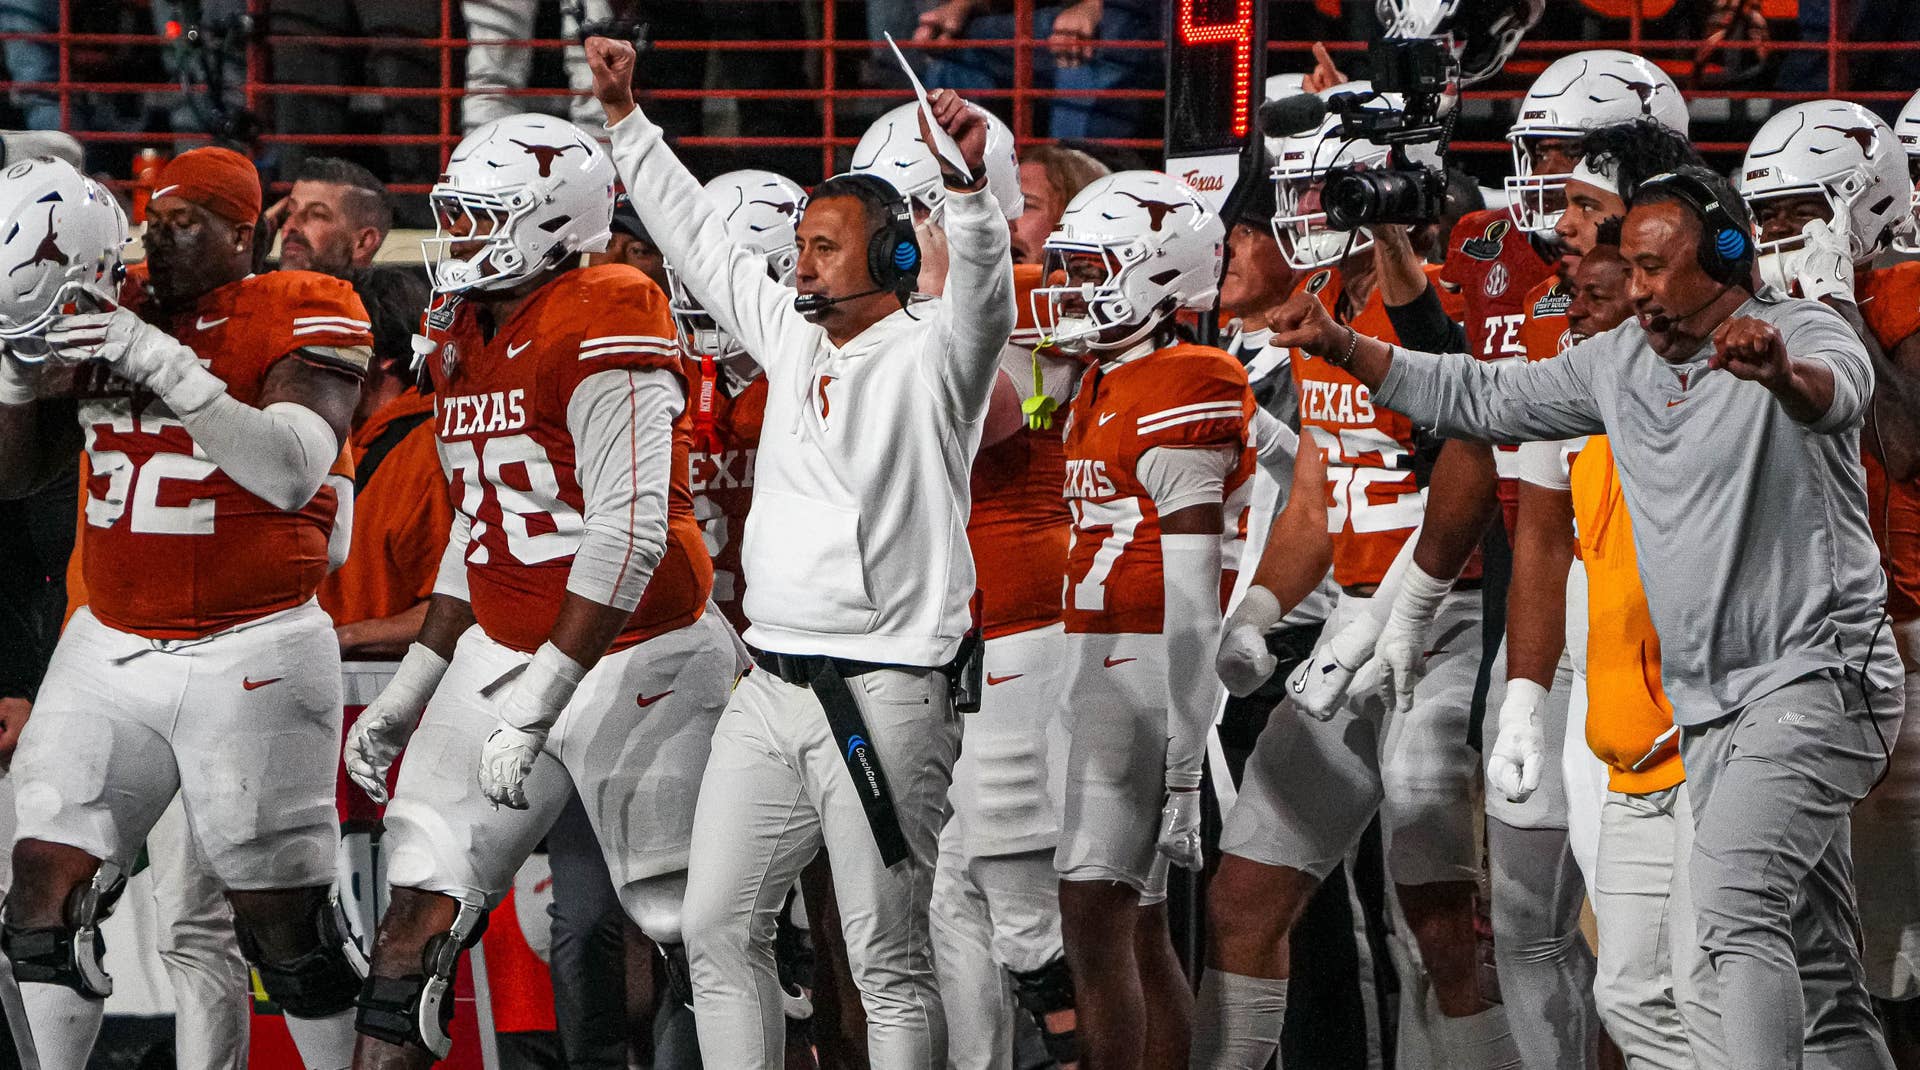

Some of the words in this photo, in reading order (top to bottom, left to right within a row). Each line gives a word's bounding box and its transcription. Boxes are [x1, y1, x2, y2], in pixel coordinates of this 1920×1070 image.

[1182, 169, 1224, 191] Texas
[441, 389, 526, 437] TEXAS
[1301, 379, 1376, 423] TEXAS
[435, 433, 586, 566] 78
[856, 747, 880, 798] CoachComm
